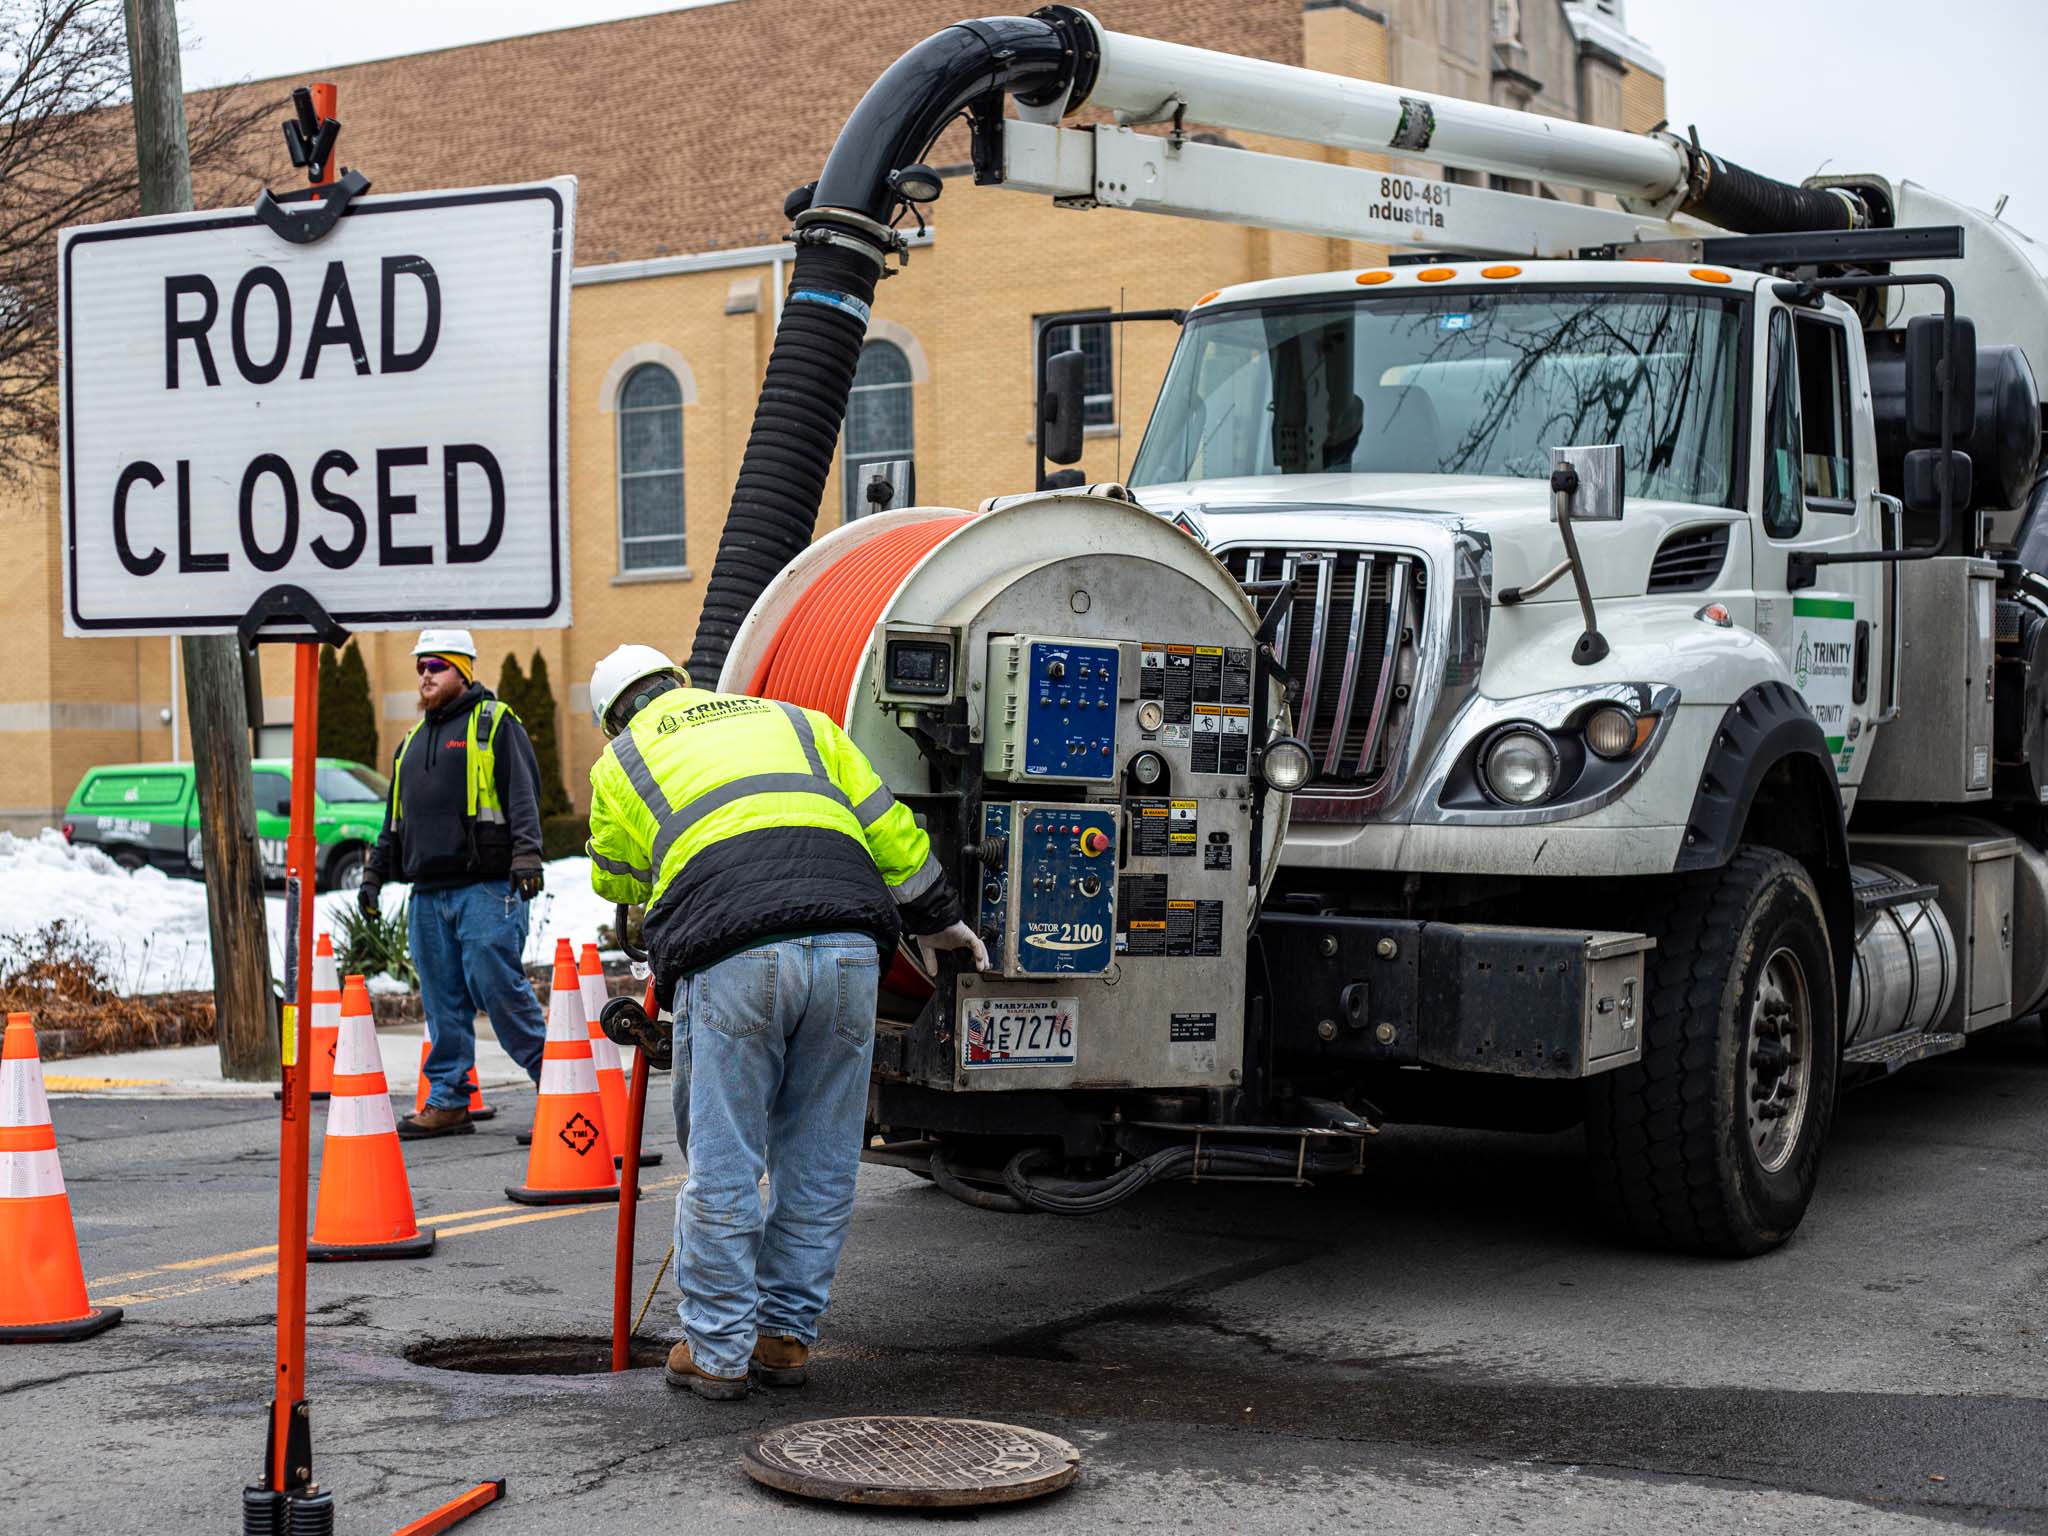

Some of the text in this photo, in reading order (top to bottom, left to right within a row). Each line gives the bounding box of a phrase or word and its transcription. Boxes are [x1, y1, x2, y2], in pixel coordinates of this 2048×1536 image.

[165, 254, 442, 390] ROAD
[113, 443, 506, 577] CLOSED
[1813, 642, 1852, 664] TRINITY
[683, 699, 760, 716] TRINITY
[1815, 704, 1845, 724] TRINITY
[1028, 922, 1103, 942] VACTOR 2100
[994, 1002, 1048, 1010] MARYLAND
